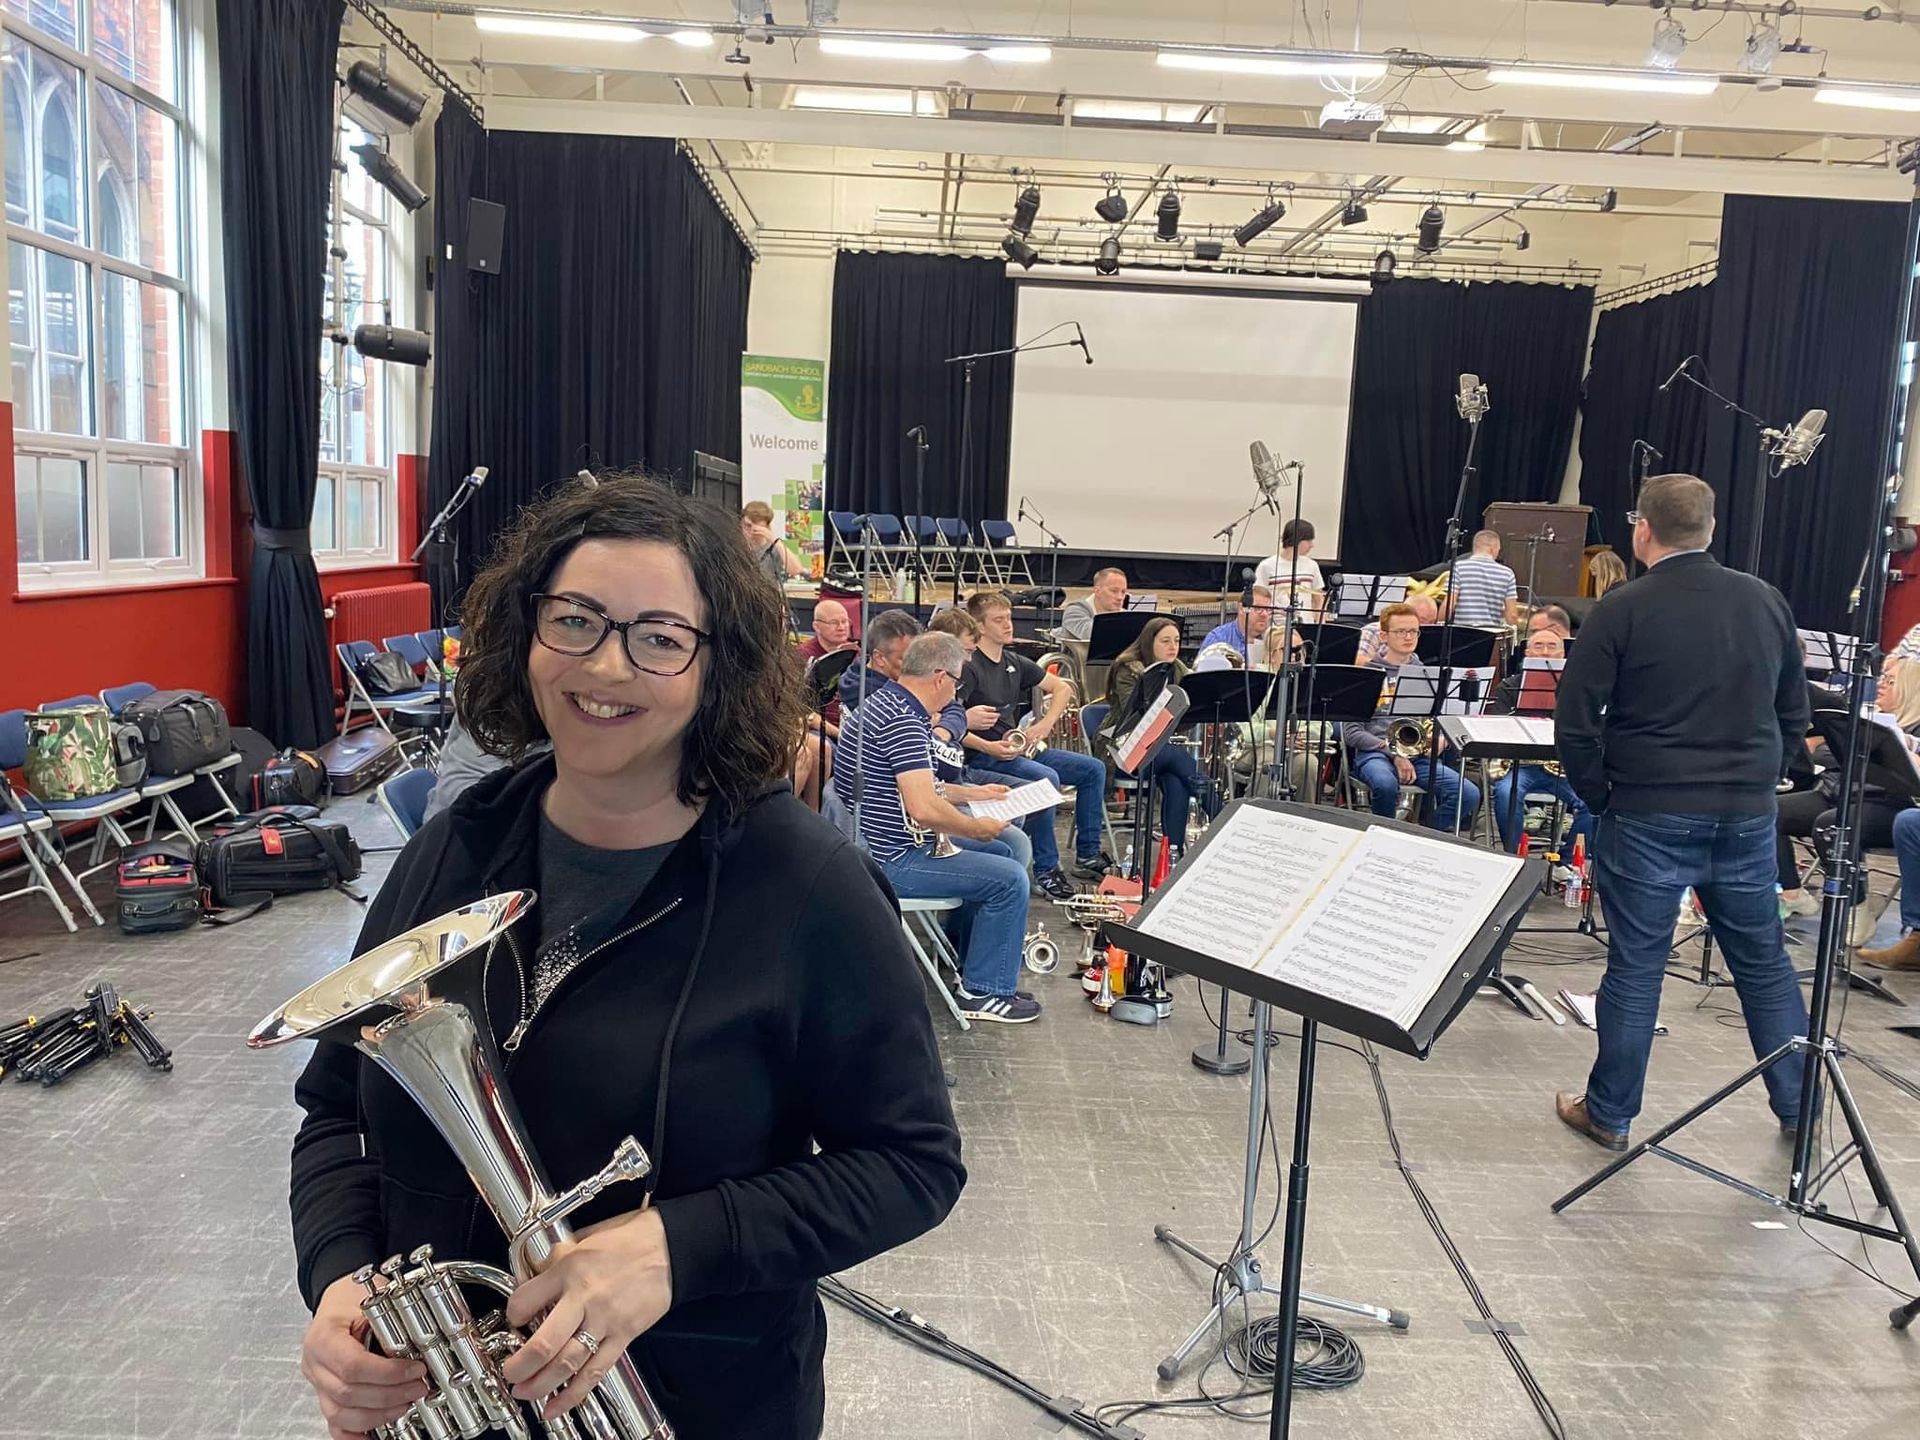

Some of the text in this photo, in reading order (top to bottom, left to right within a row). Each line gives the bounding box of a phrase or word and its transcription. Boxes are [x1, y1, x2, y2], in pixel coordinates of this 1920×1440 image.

[744, 363, 789, 374] SANDBACH
[791, 366, 821, 377] SCHOOL
[750, 434, 818, 451] Welcome
